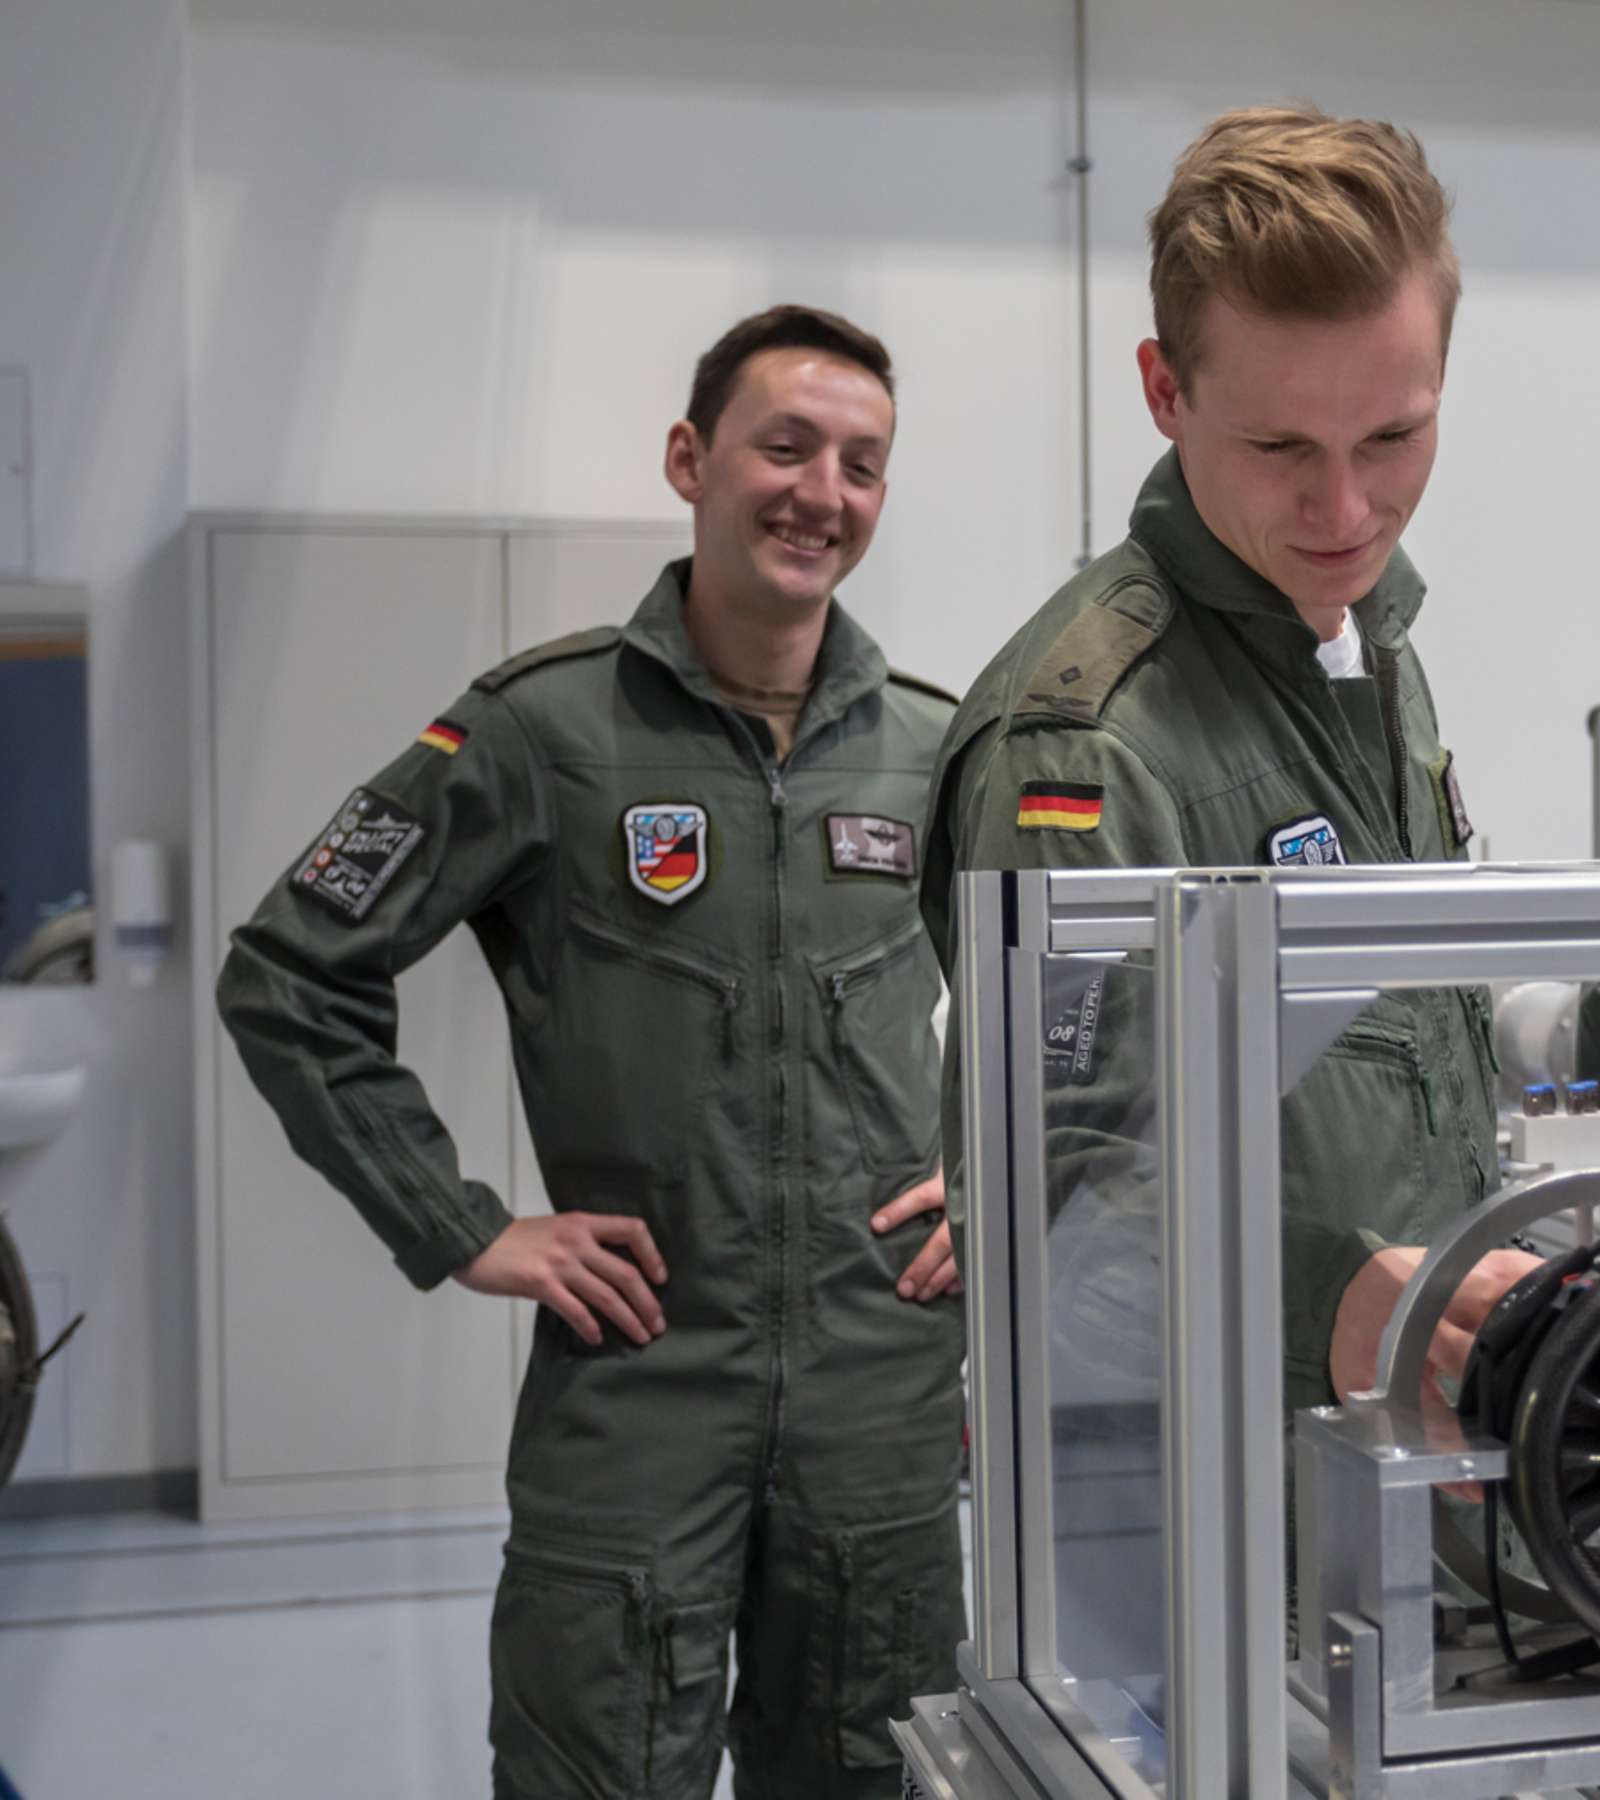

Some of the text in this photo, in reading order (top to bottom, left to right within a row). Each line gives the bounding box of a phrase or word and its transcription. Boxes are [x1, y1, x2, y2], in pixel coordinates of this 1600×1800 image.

[1084, 1009, 1096, 1026] TO
[1049, 1025, 1075, 1041] 08
[1077, 1031, 1092, 1071] AGED
